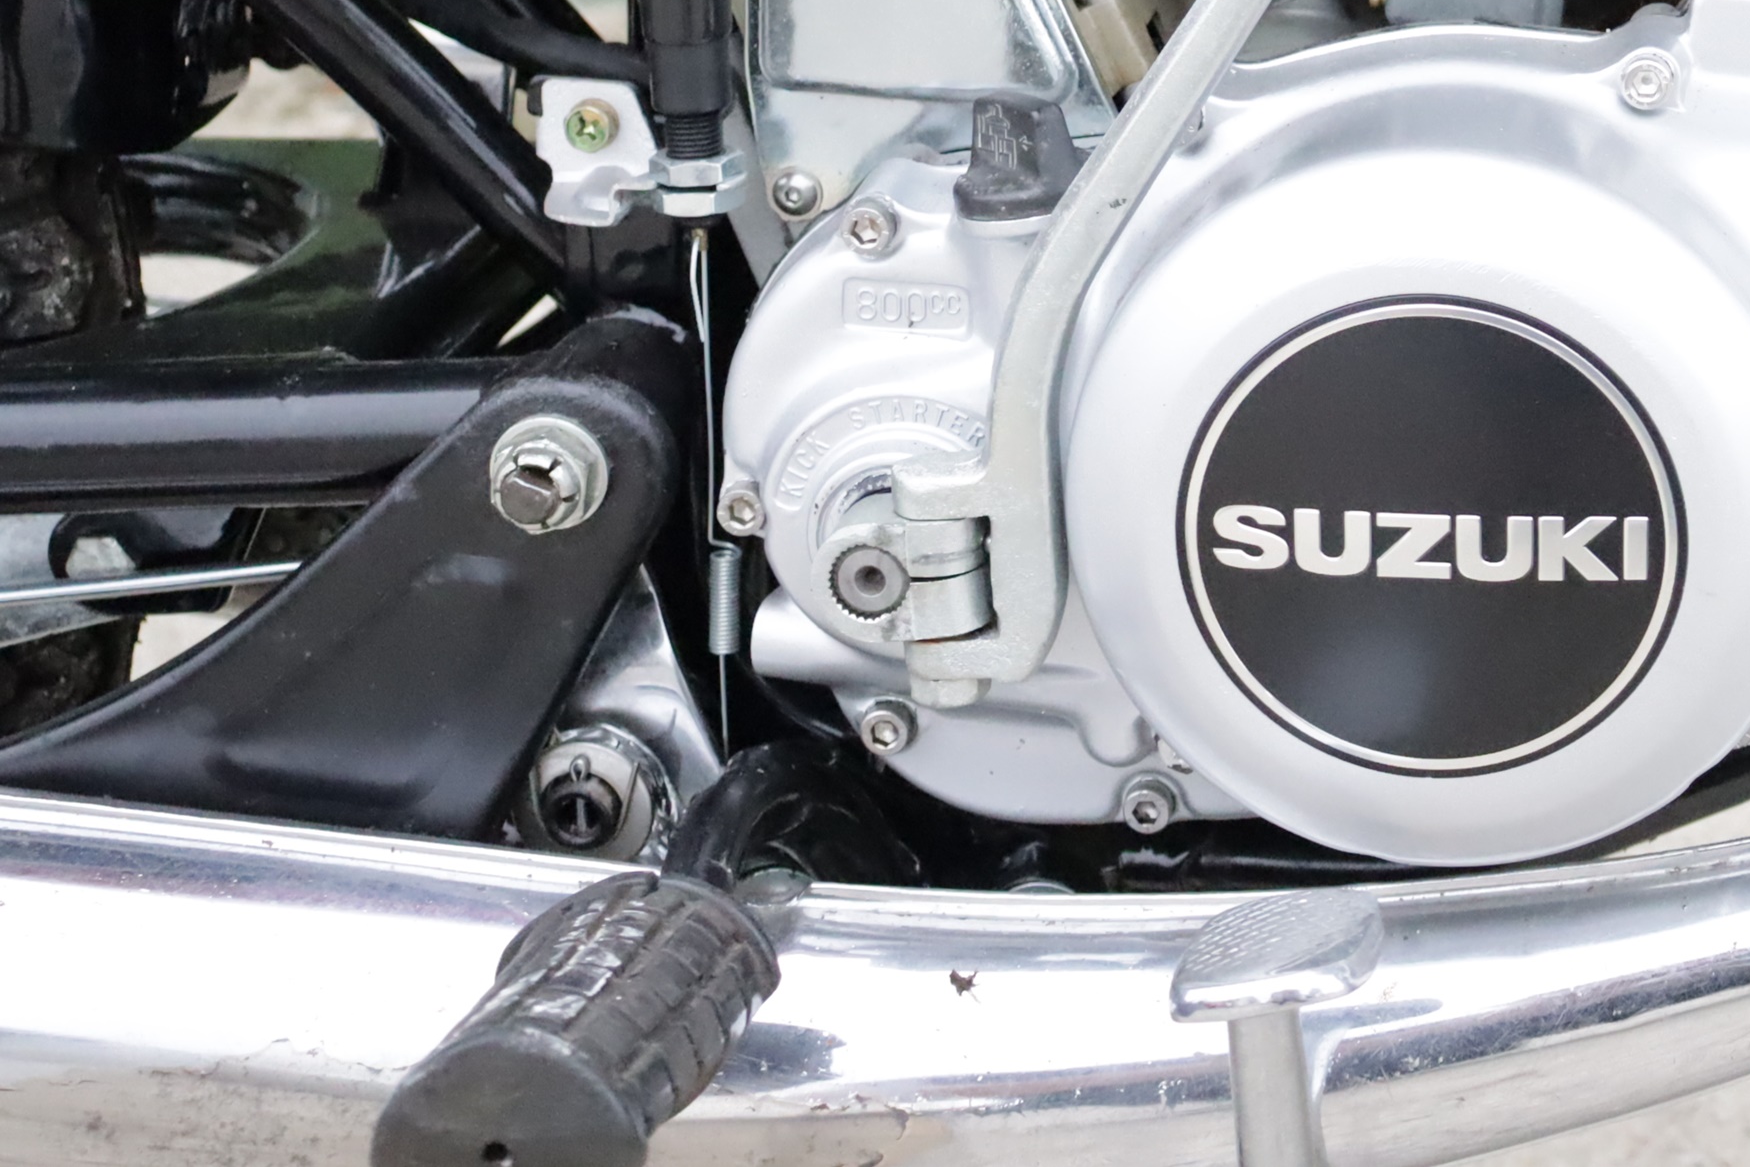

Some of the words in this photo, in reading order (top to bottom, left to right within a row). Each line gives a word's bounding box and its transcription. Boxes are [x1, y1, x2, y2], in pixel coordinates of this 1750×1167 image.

[779, 432, 831, 498] KICK
[848, 398, 986, 448] STARTER
[1212, 504, 1649, 582] SUZUKI
